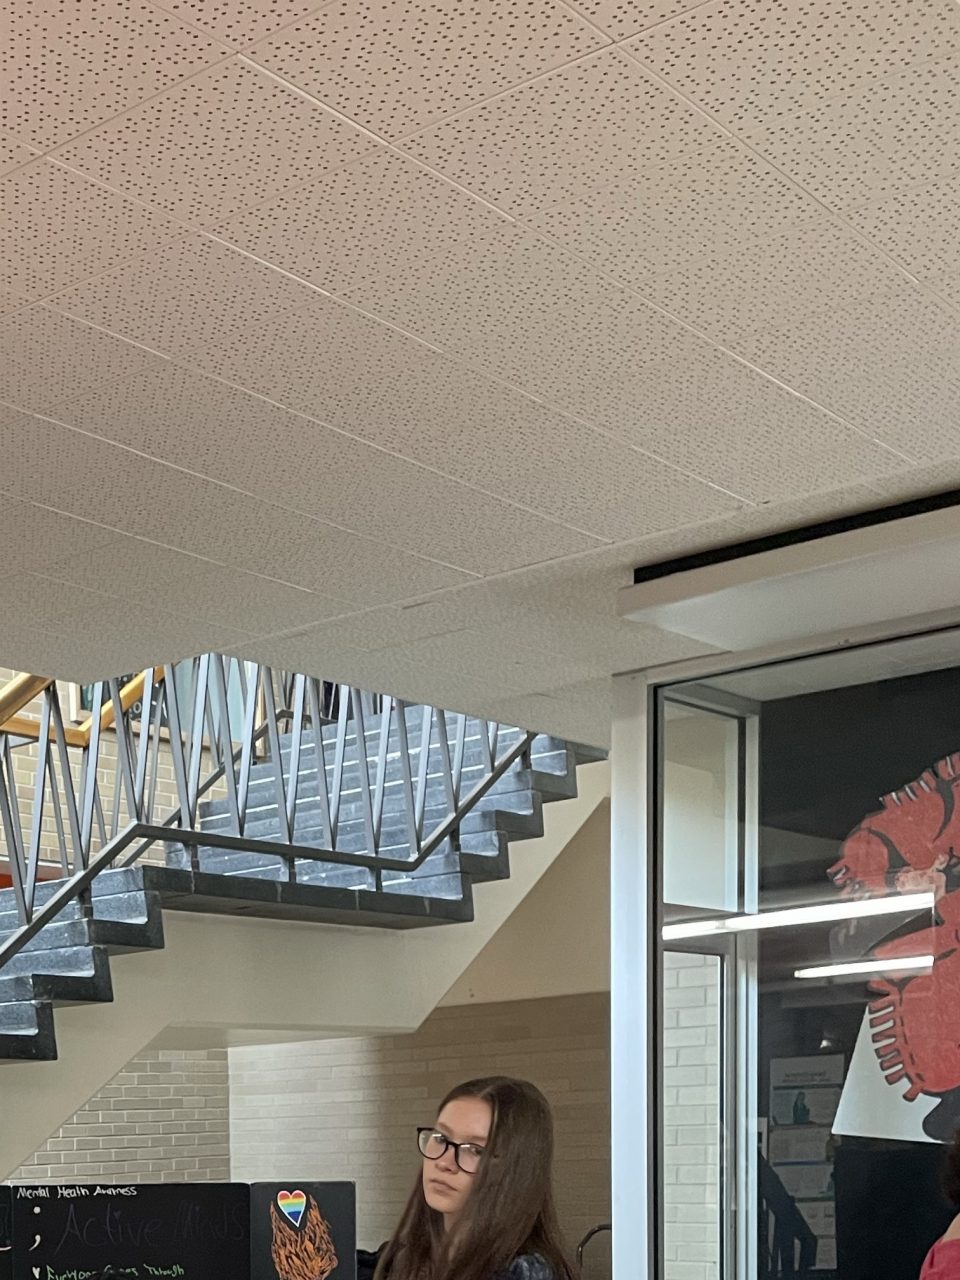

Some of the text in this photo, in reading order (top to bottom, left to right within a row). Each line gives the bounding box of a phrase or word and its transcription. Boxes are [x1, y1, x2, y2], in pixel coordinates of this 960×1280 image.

[17, 1186, 50, 1199] Mental
[57, 1185, 90, 1198] Health
[53, 1203, 162, 1256] Active
